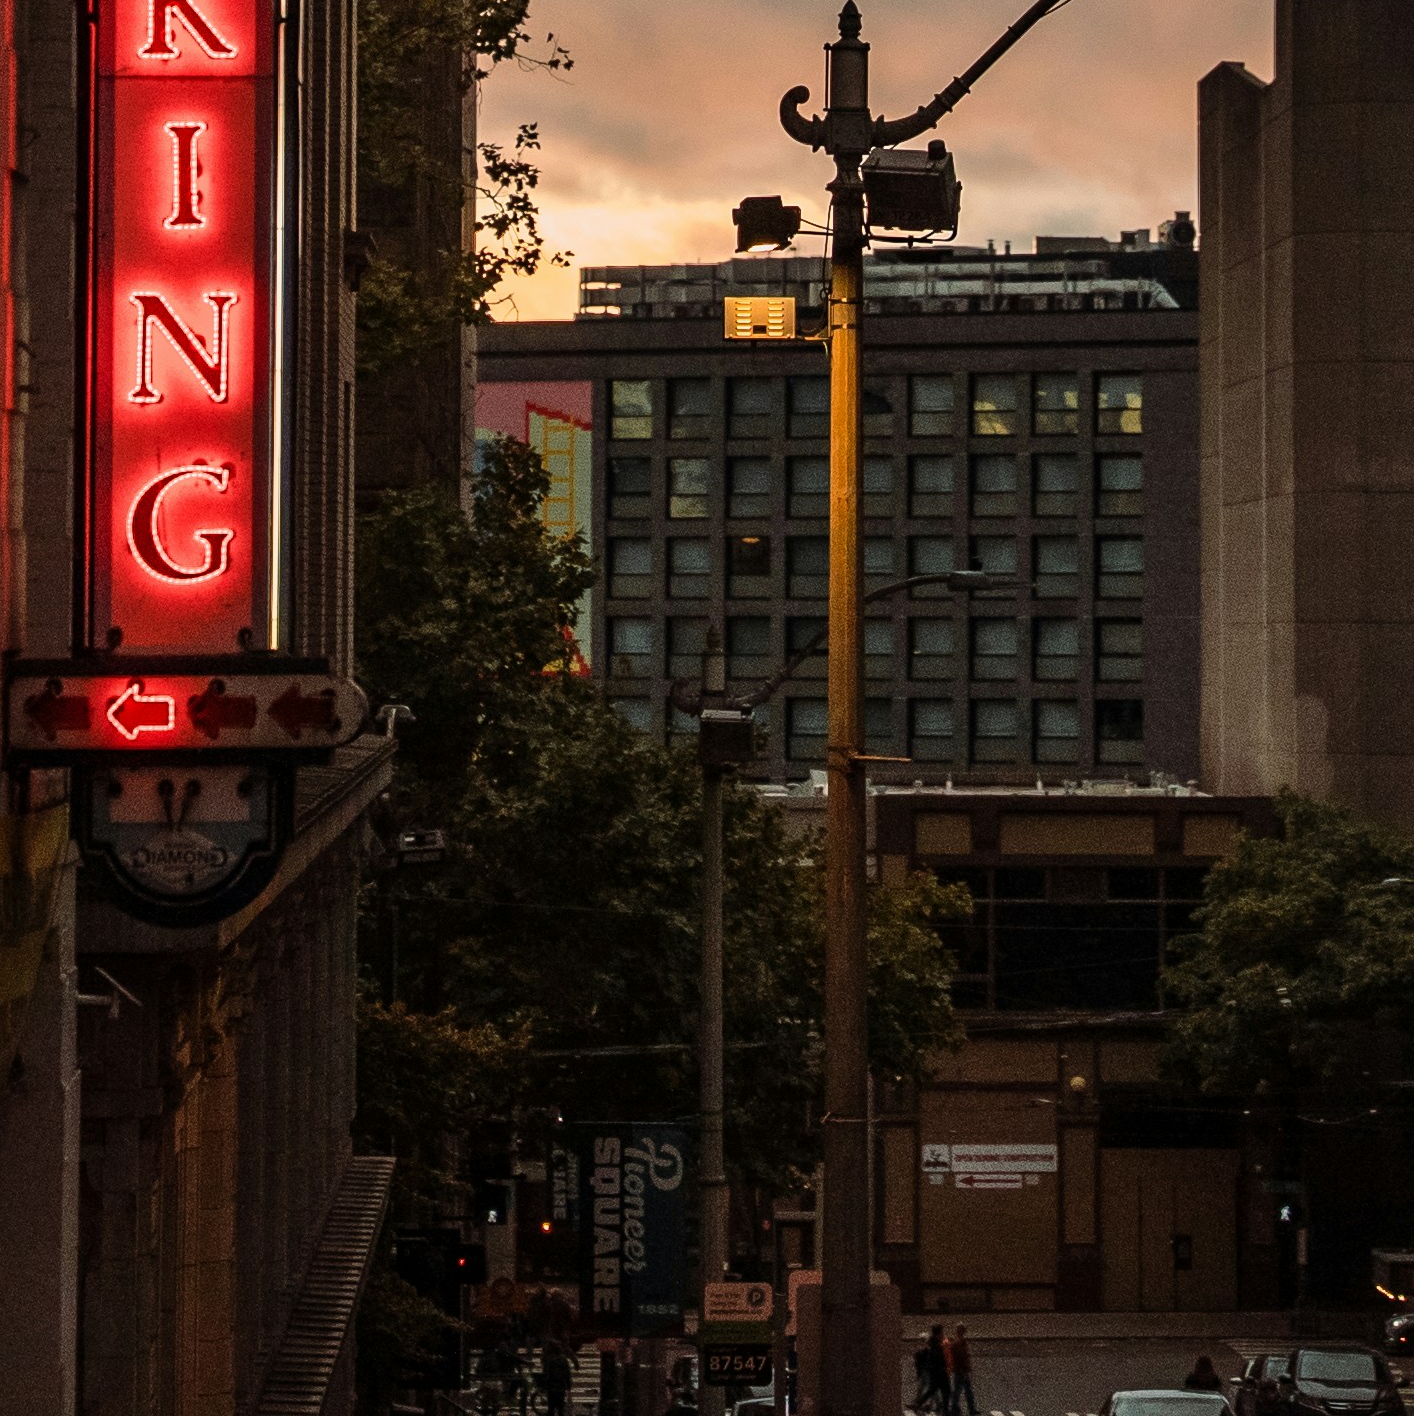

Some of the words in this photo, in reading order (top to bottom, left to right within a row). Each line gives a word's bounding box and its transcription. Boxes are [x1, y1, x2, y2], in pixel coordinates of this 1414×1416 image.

[591, 1138, 620, 1313] SQUARE
[624, 1138, 683, 1275] Pioneer
[709, 1355, 767, 1371] 87547
